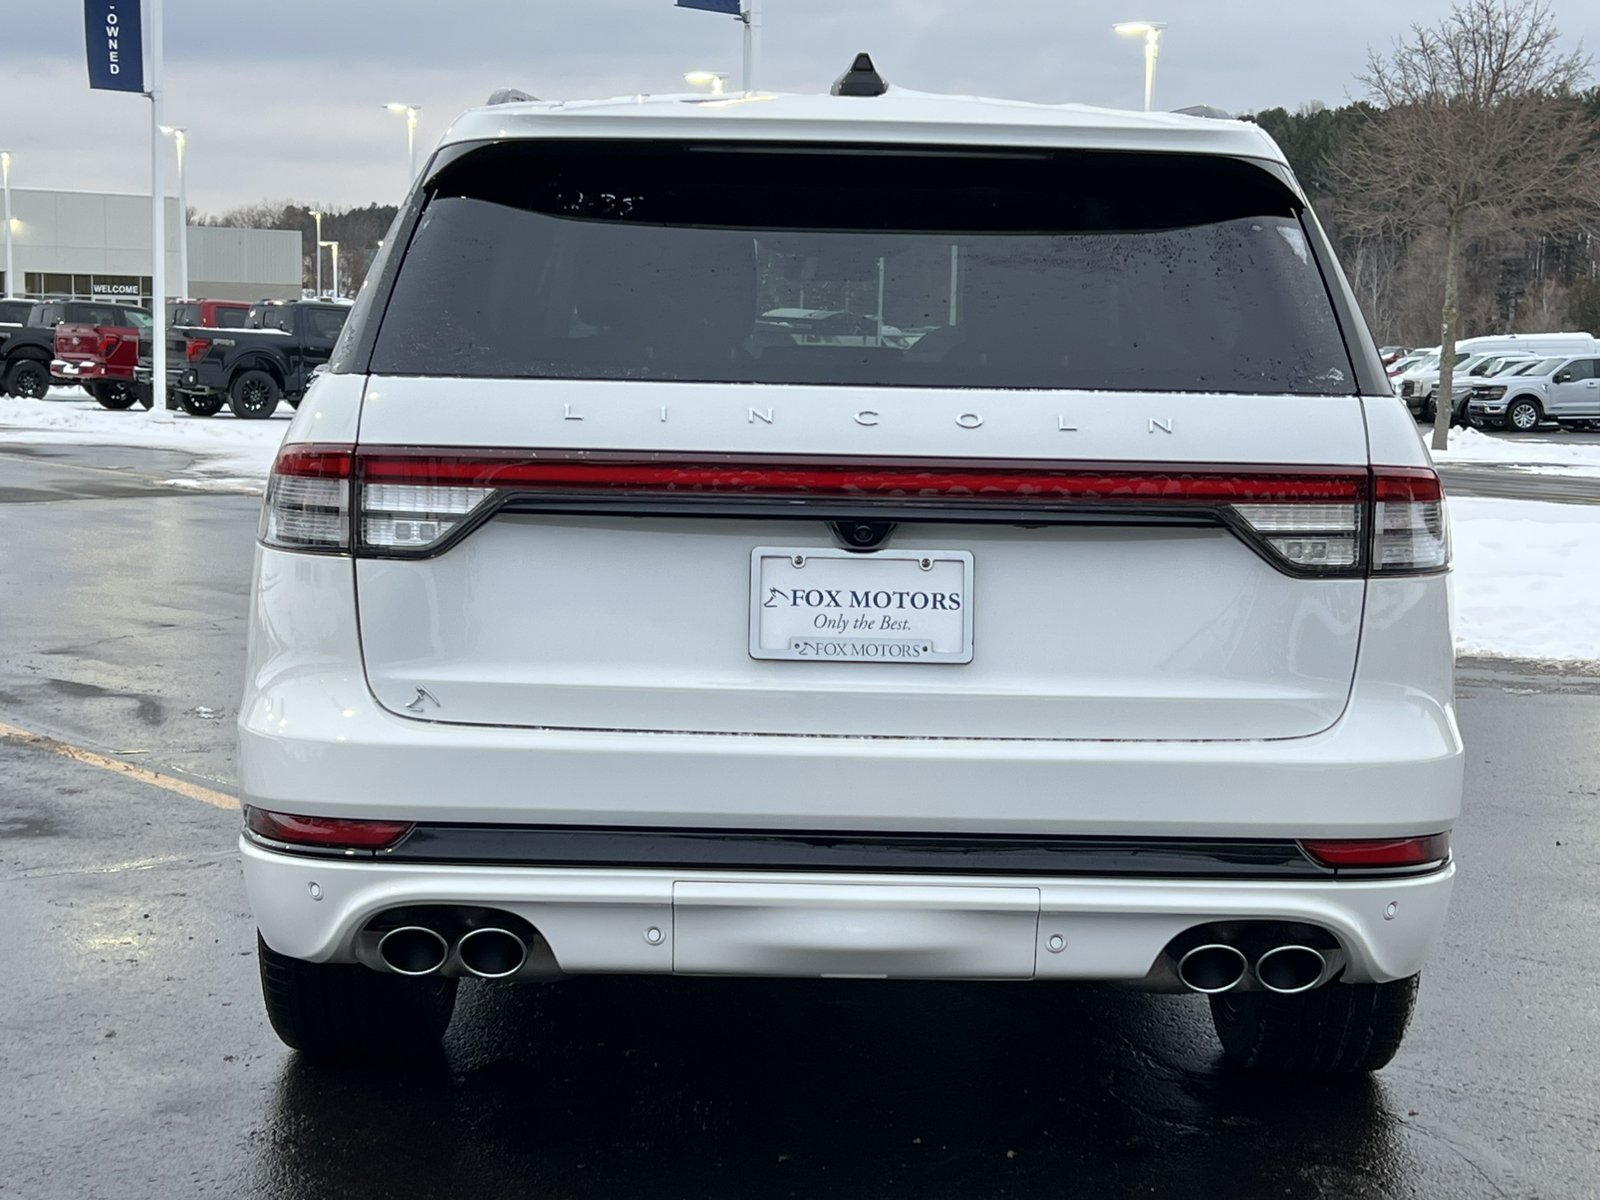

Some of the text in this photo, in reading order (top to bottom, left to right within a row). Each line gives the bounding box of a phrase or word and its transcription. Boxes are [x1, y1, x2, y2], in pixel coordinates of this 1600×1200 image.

[93, 284, 139, 294] WELCOME
[564, 403, 1172, 434] LINCOLN
[790, 588, 961, 611] FOX MOTORS
[813, 613, 912, 635] Only the Best.
[815, 642, 921, 658] FOX MOTORS
